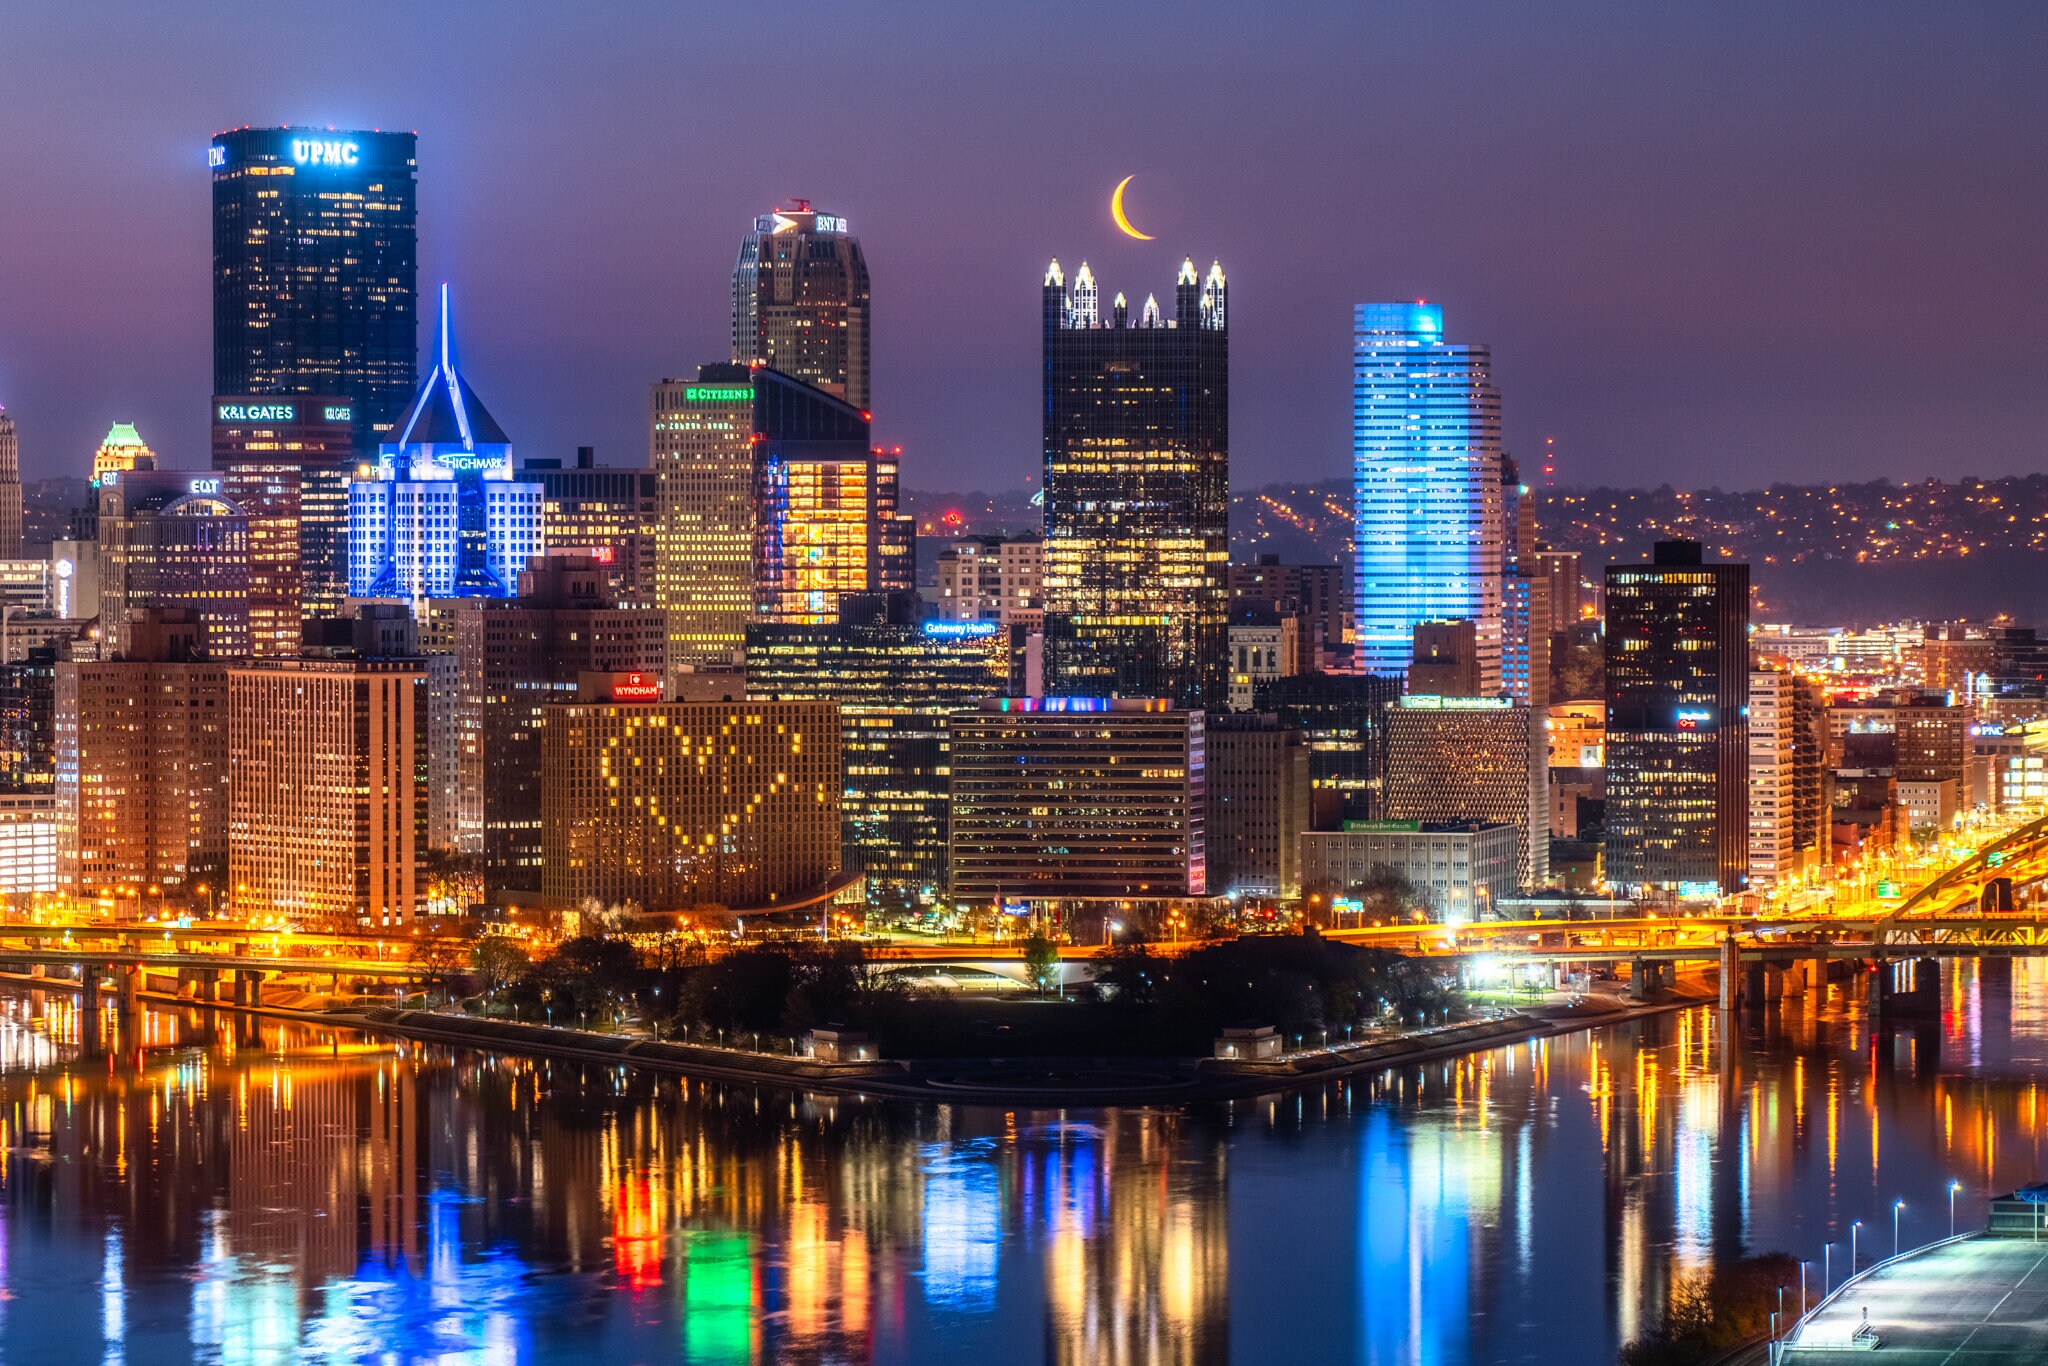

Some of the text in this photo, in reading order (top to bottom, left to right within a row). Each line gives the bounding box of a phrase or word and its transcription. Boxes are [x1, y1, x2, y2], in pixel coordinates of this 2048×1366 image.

[208, 146, 225, 167] UPMC
[293, 140, 358, 164] UPMC
[818, 216, 835, 231] BNY
[698, 389, 748, 399] CITIZENS
[220, 406, 293, 420] K&L GATES
[445, 457, 502, 469] HIGHMARK
[102, 472, 118, 486] EQT
[191, 480, 219, 493] EQT
[926, 623, 996, 635] Gateway Health
[615, 687, 657, 695] WYNDHAM
[1411, 697, 1441, 707] United
[1982, 726, 2004, 736] PNC
